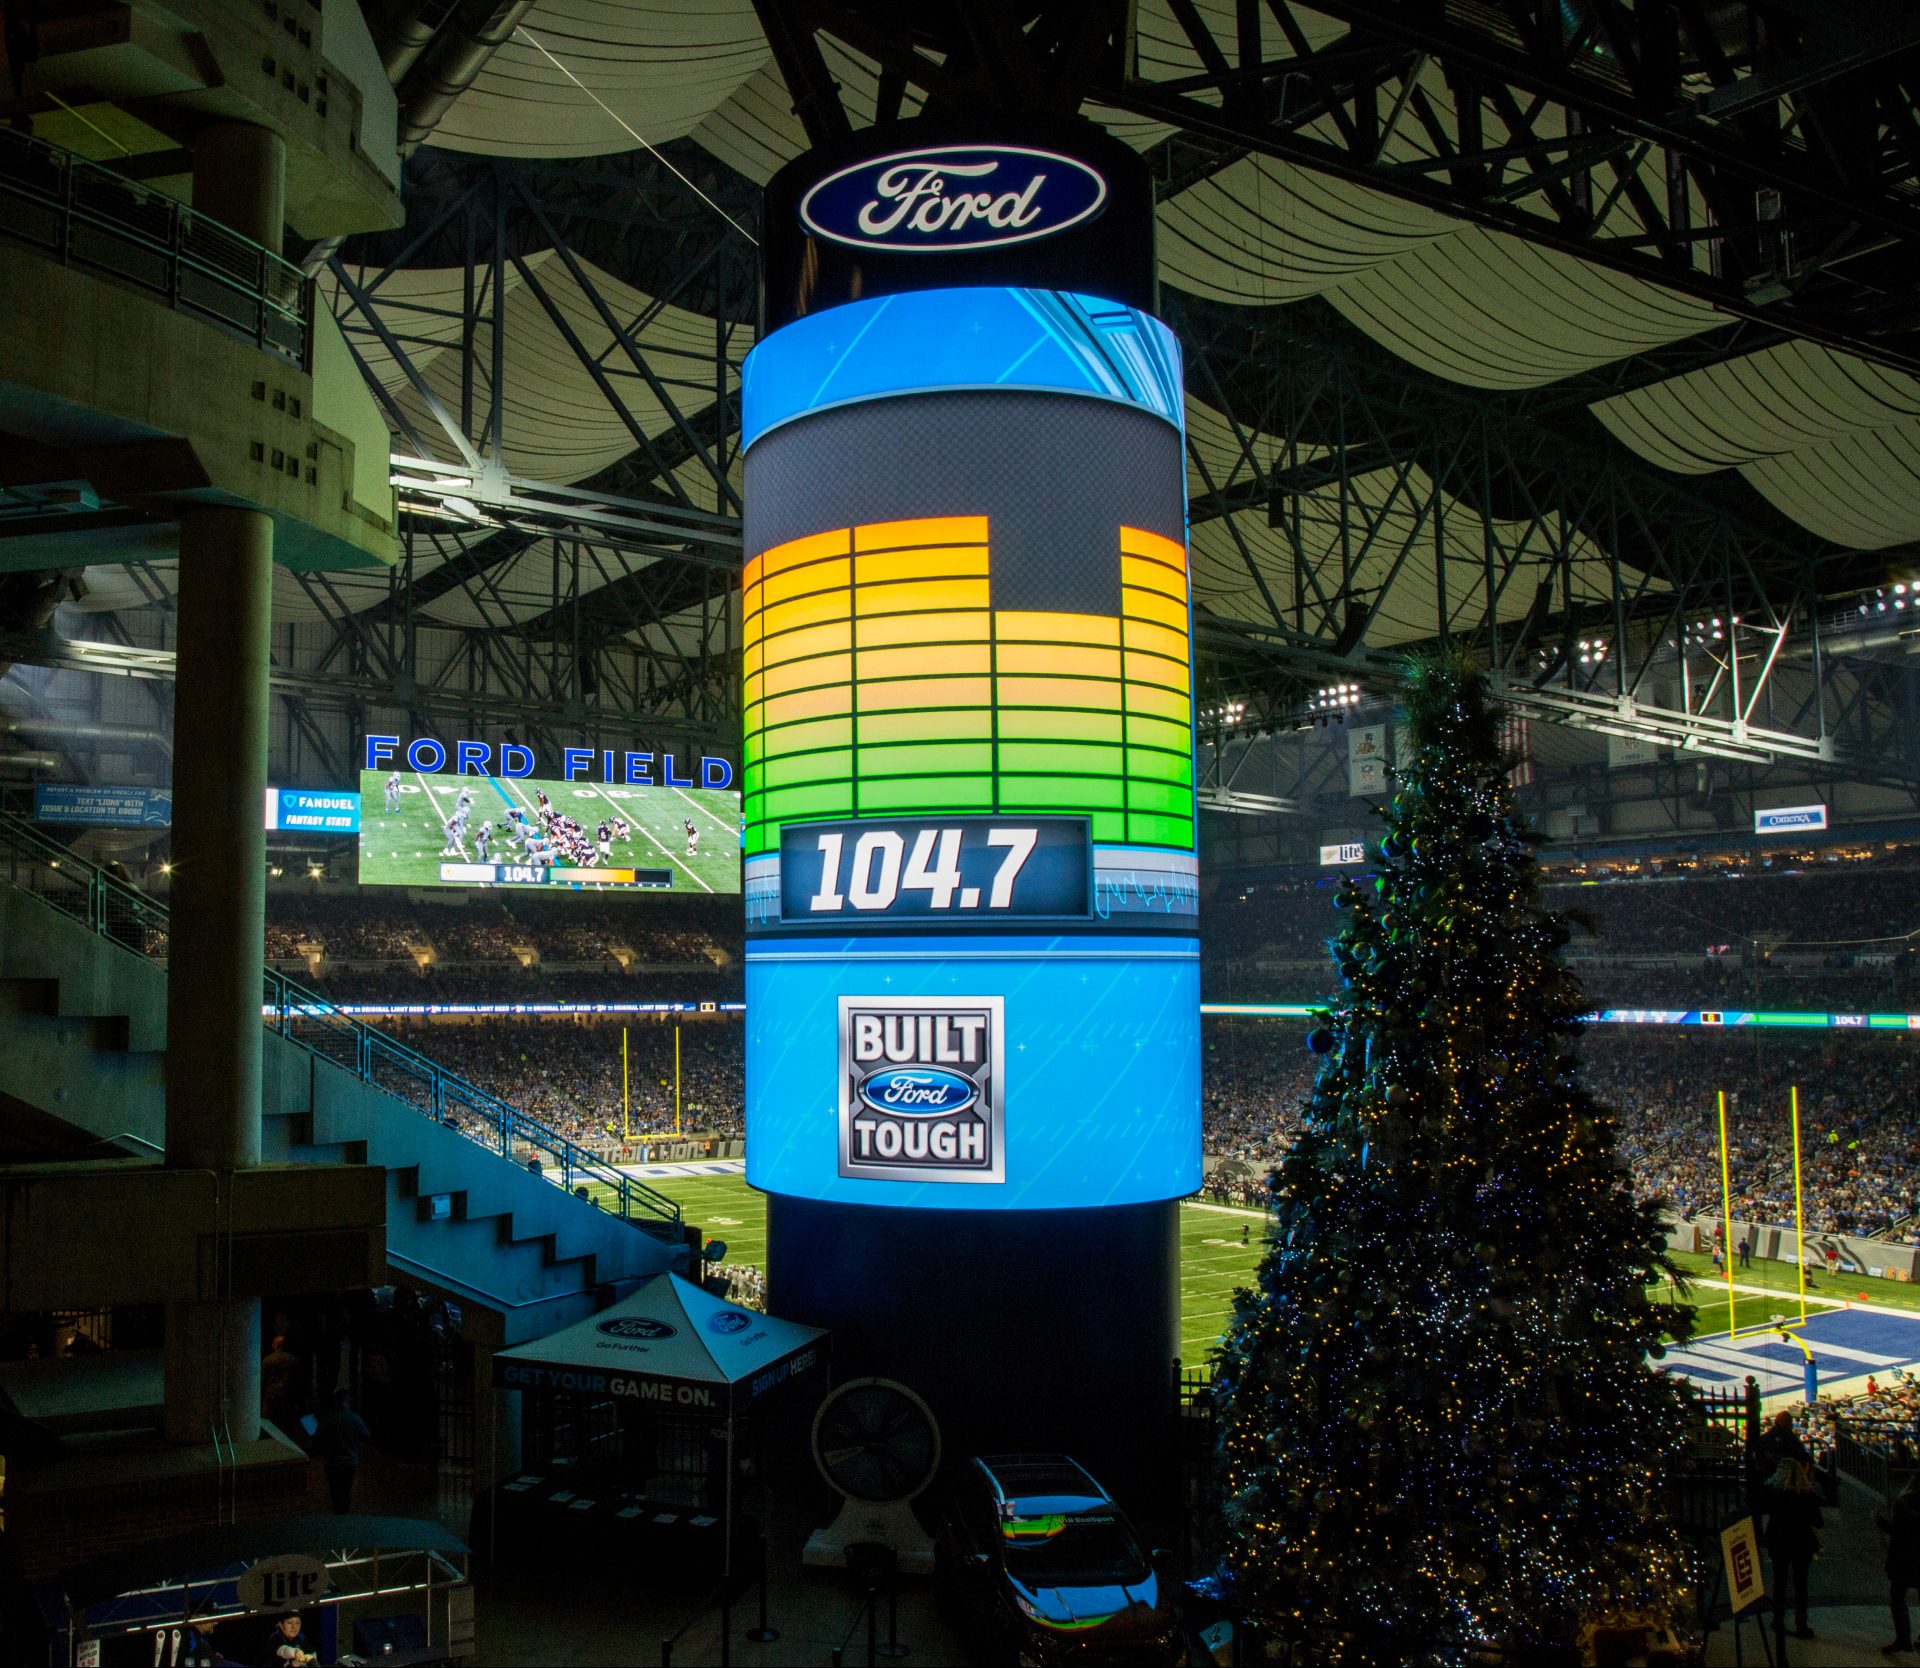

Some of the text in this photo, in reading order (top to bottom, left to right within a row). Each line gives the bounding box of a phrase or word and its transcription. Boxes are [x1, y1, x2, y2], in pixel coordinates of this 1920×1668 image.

[858, 161, 1047, 235] Ford
[365, 734, 733, 790] FORD FIELD
[41, 805, 63, 813] ISSUE
[71, 806, 106, 814] LOCATION
[77, 798, 94, 806] TEXT
[298, 797, 355, 810] FANDUEL
[285, 814, 352, 827] FANTASY STATS
[503, 867, 544, 882] 104.7
[810, 828, 1039, 911] 104.7
[855, 1015, 985, 1063] BUILT
[884, 1075, 949, 1104] Ford
[854, 1119, 985, 1160] TOUGH
[609, 1319, 662, 1337] Ford
[596, 1342, 649, 1353] Go Further
[503, 1365, 717, 1408] GET YOUR GAME ON.
[752, 1370, 775, 1399] SIGN
[776, 1362, 788, 1383] UP
[261, 1571, 318, 1607] Lite
